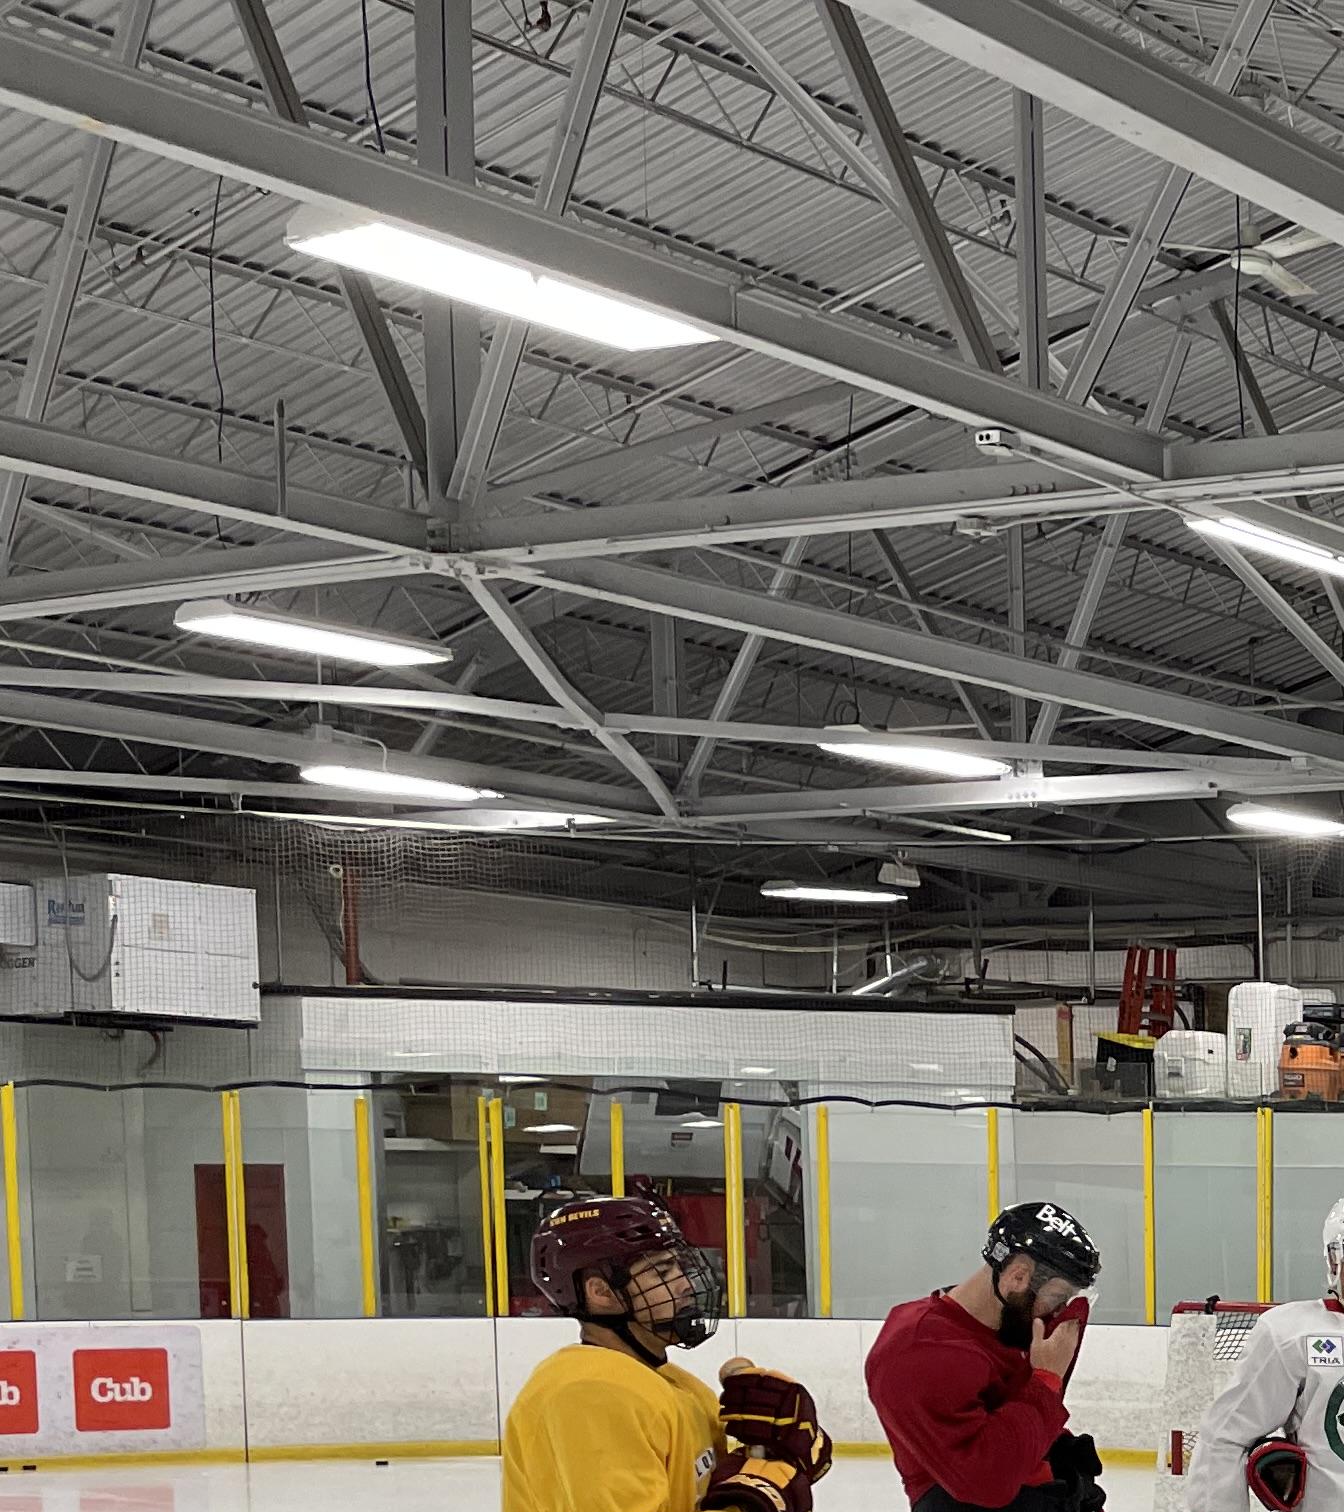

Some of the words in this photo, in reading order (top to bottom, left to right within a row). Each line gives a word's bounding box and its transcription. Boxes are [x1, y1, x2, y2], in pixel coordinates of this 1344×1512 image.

[568, 1208, 600, 1221] DEVILS
[1311, 1356, 1341, 1365] TRIA
[91, 1376, 152, 1402] Cub
